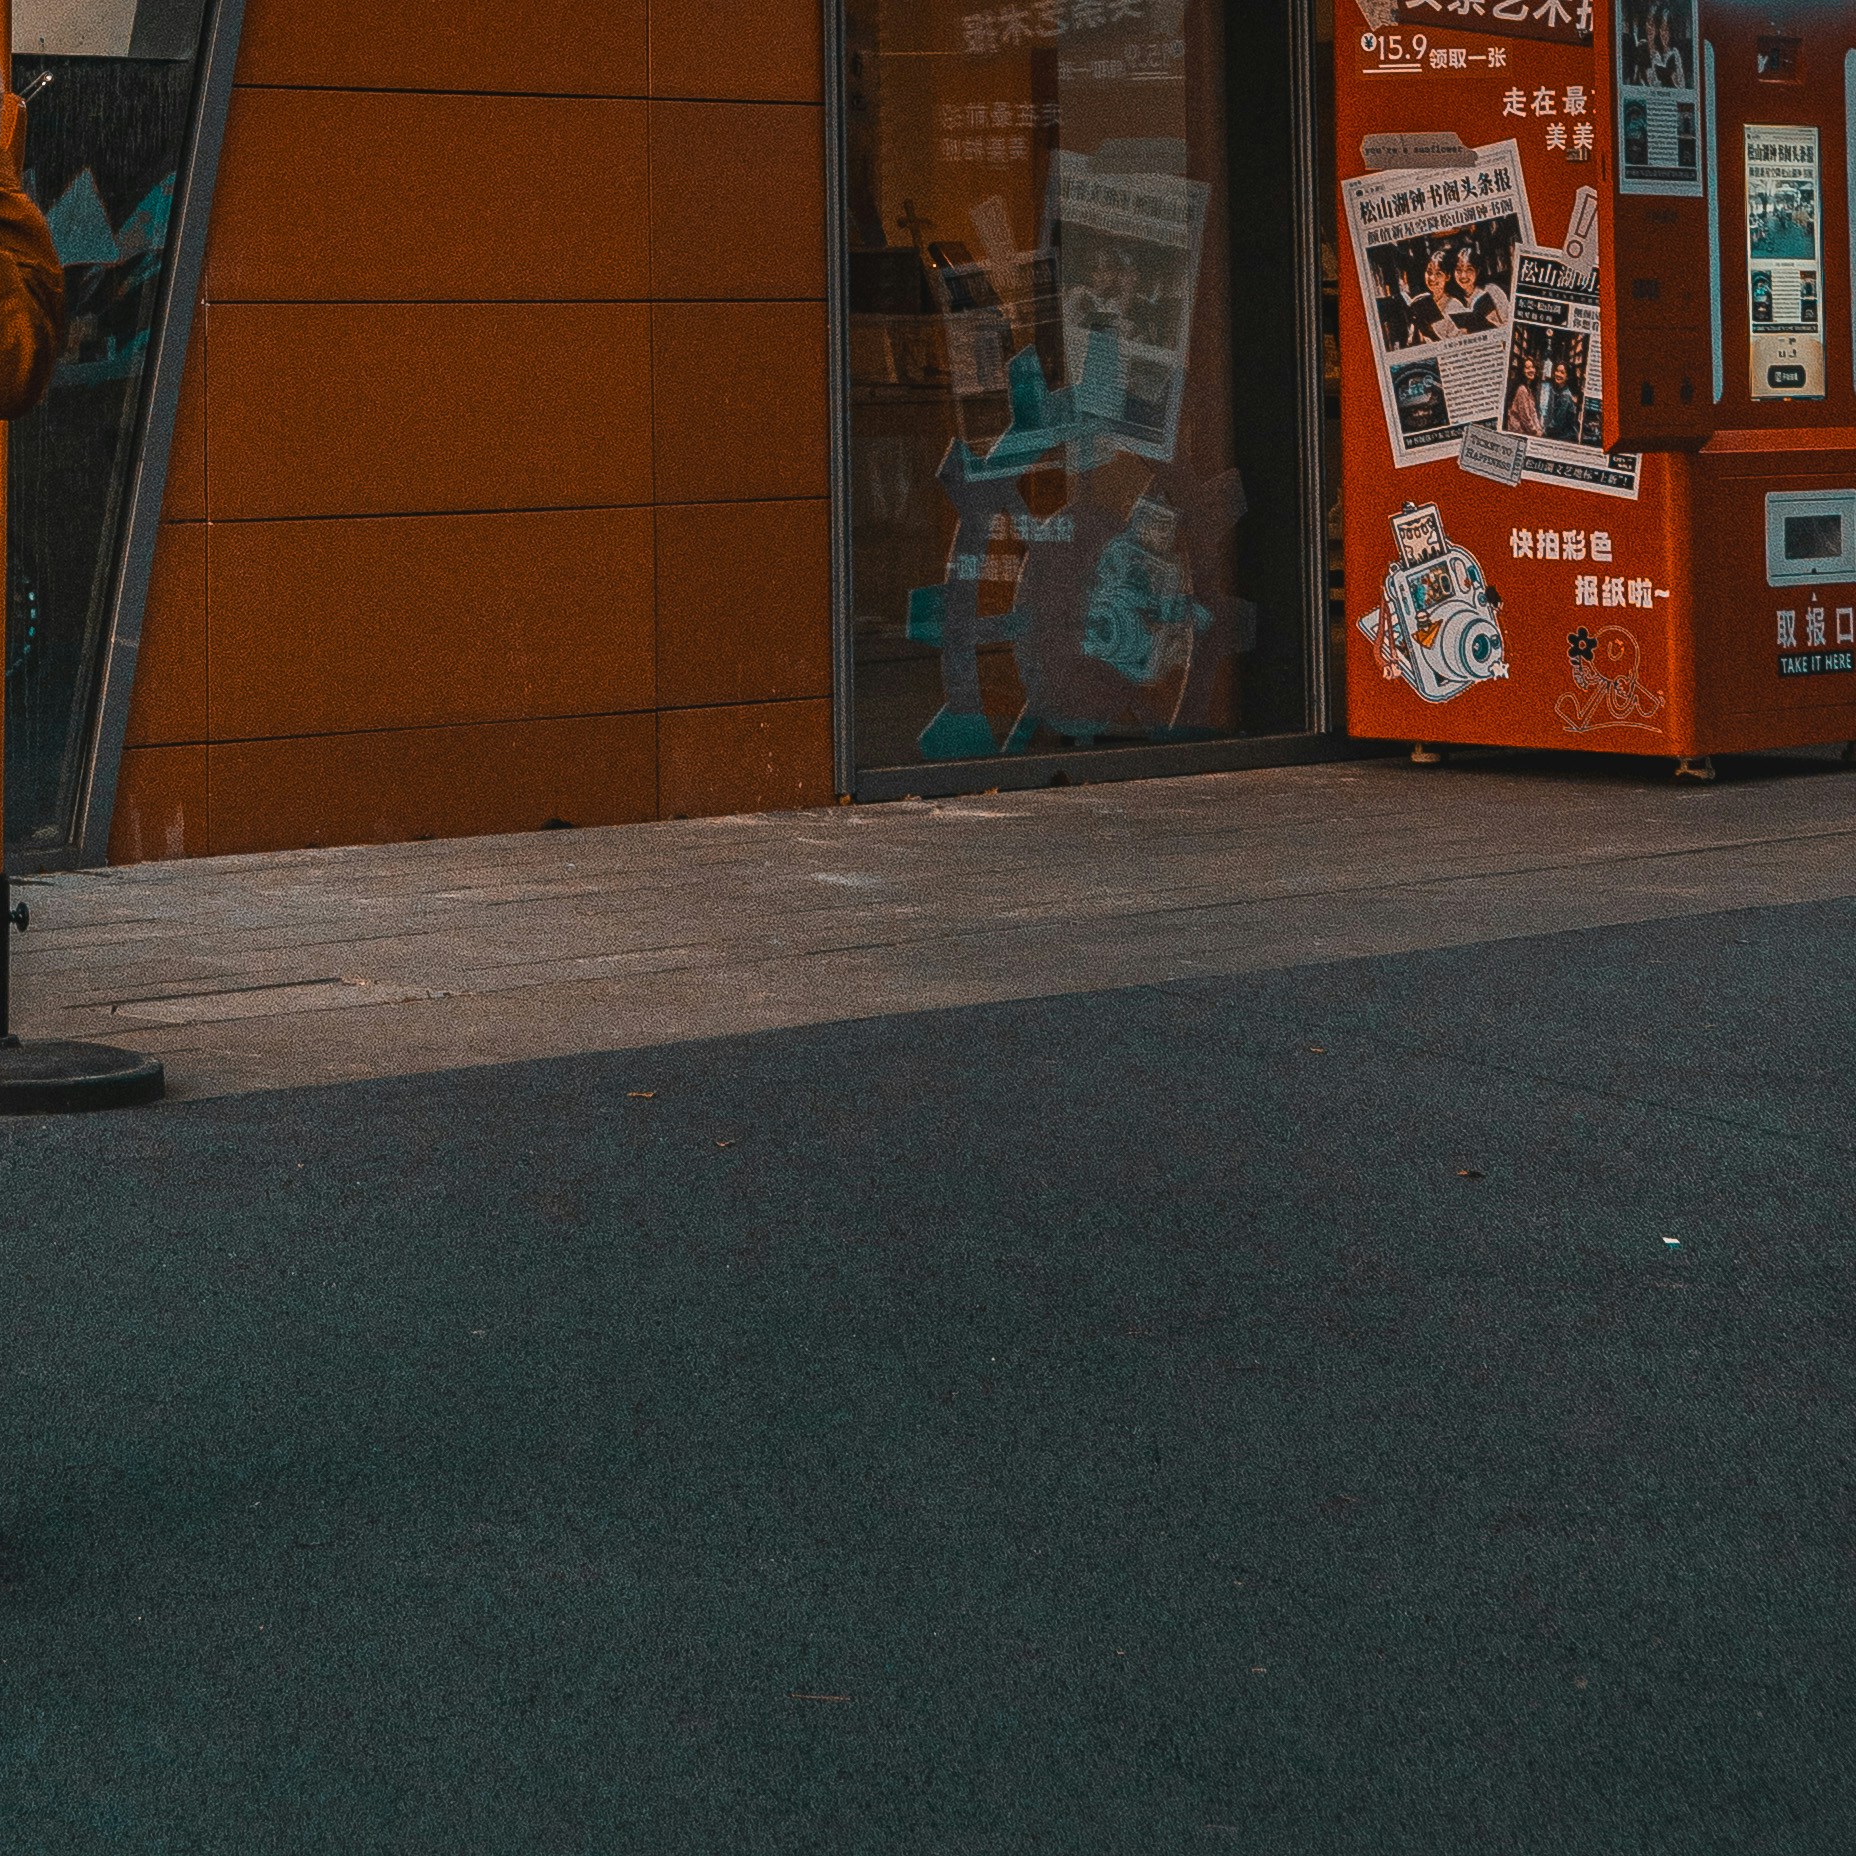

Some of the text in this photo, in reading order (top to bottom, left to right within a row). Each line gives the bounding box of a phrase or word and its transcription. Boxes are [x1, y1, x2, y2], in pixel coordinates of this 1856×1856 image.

[1429, 46, 1507, 69] 领取一张
[1502, 85, 1597, 118] 走在最
[1510, 527, 1613, 563] 快拍彩色
[1776, 606, 1854, 649] 取报口
[1780, 653, 1852, 674] TAKE IT HERE
